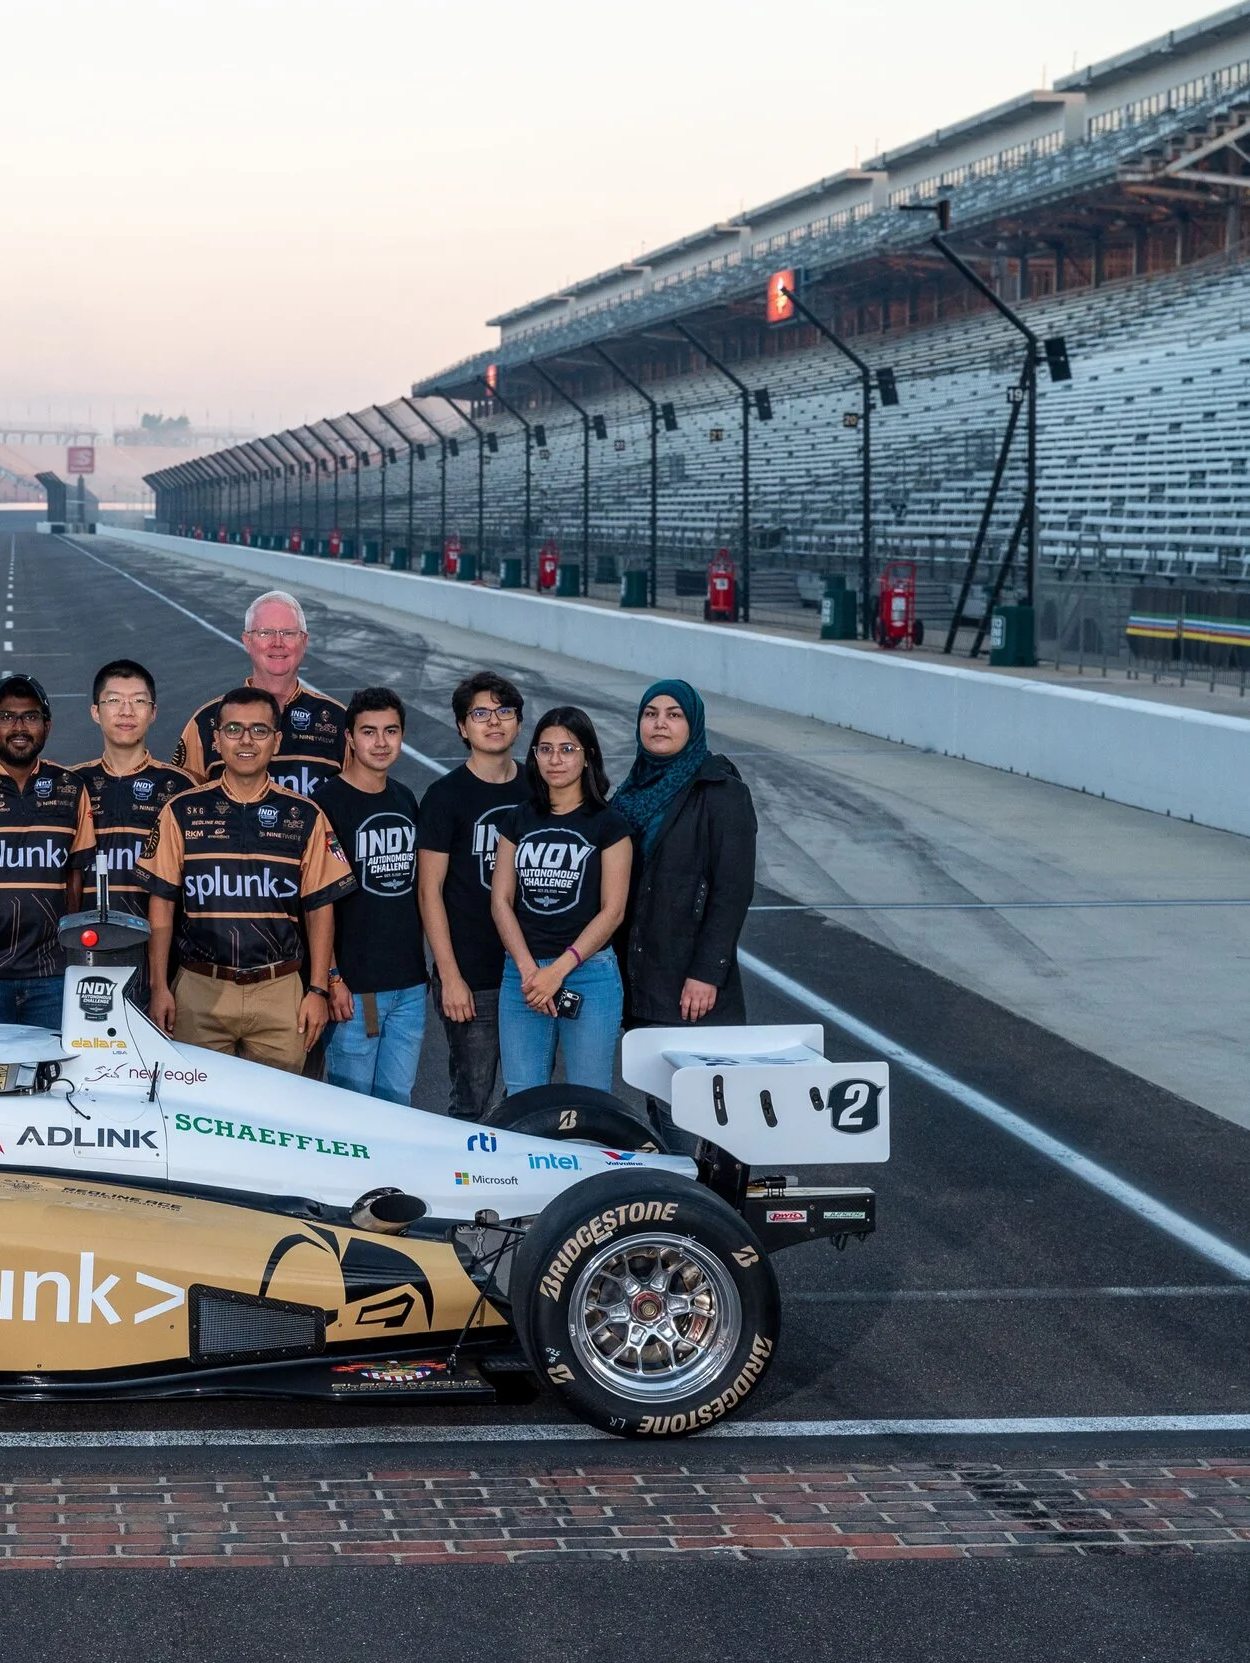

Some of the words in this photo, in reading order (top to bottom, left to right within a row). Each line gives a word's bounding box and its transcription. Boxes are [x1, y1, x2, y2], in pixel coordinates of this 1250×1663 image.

[1008, 389, 1023, 401] 19
[290, 710, 311, 718] INDY
[133, 781, 155, 789] INDY
[258, 808, 279, 816] INDY
[358, 826, 415, 858] INDY
[370, 862, 410, 874] CHALLENG
[520, 868, 580, 881] AUTONOMOUS
[523, 877, 574, 888] CHALLENGE
[77, 981, 116, 996] INDY
[71, 1037, 127, 1049] dallara
[129, 1068, 161, 1080] new
[164, 1068, 208, 1085] eagle
[837, 1082, 870, 1126] 2
[16, 1125, 159, 1149] ADLINK
[175, 1113, 370, 1159] SCHAEFFLER
[467, 1132, 498, 1153] rti
[472, 1174, 519, 1186] Microsoft
[539, 1201, 679, 1303] BRIDGESTONE
[637, 1333, 773, 1435] BRIDGESTONE
